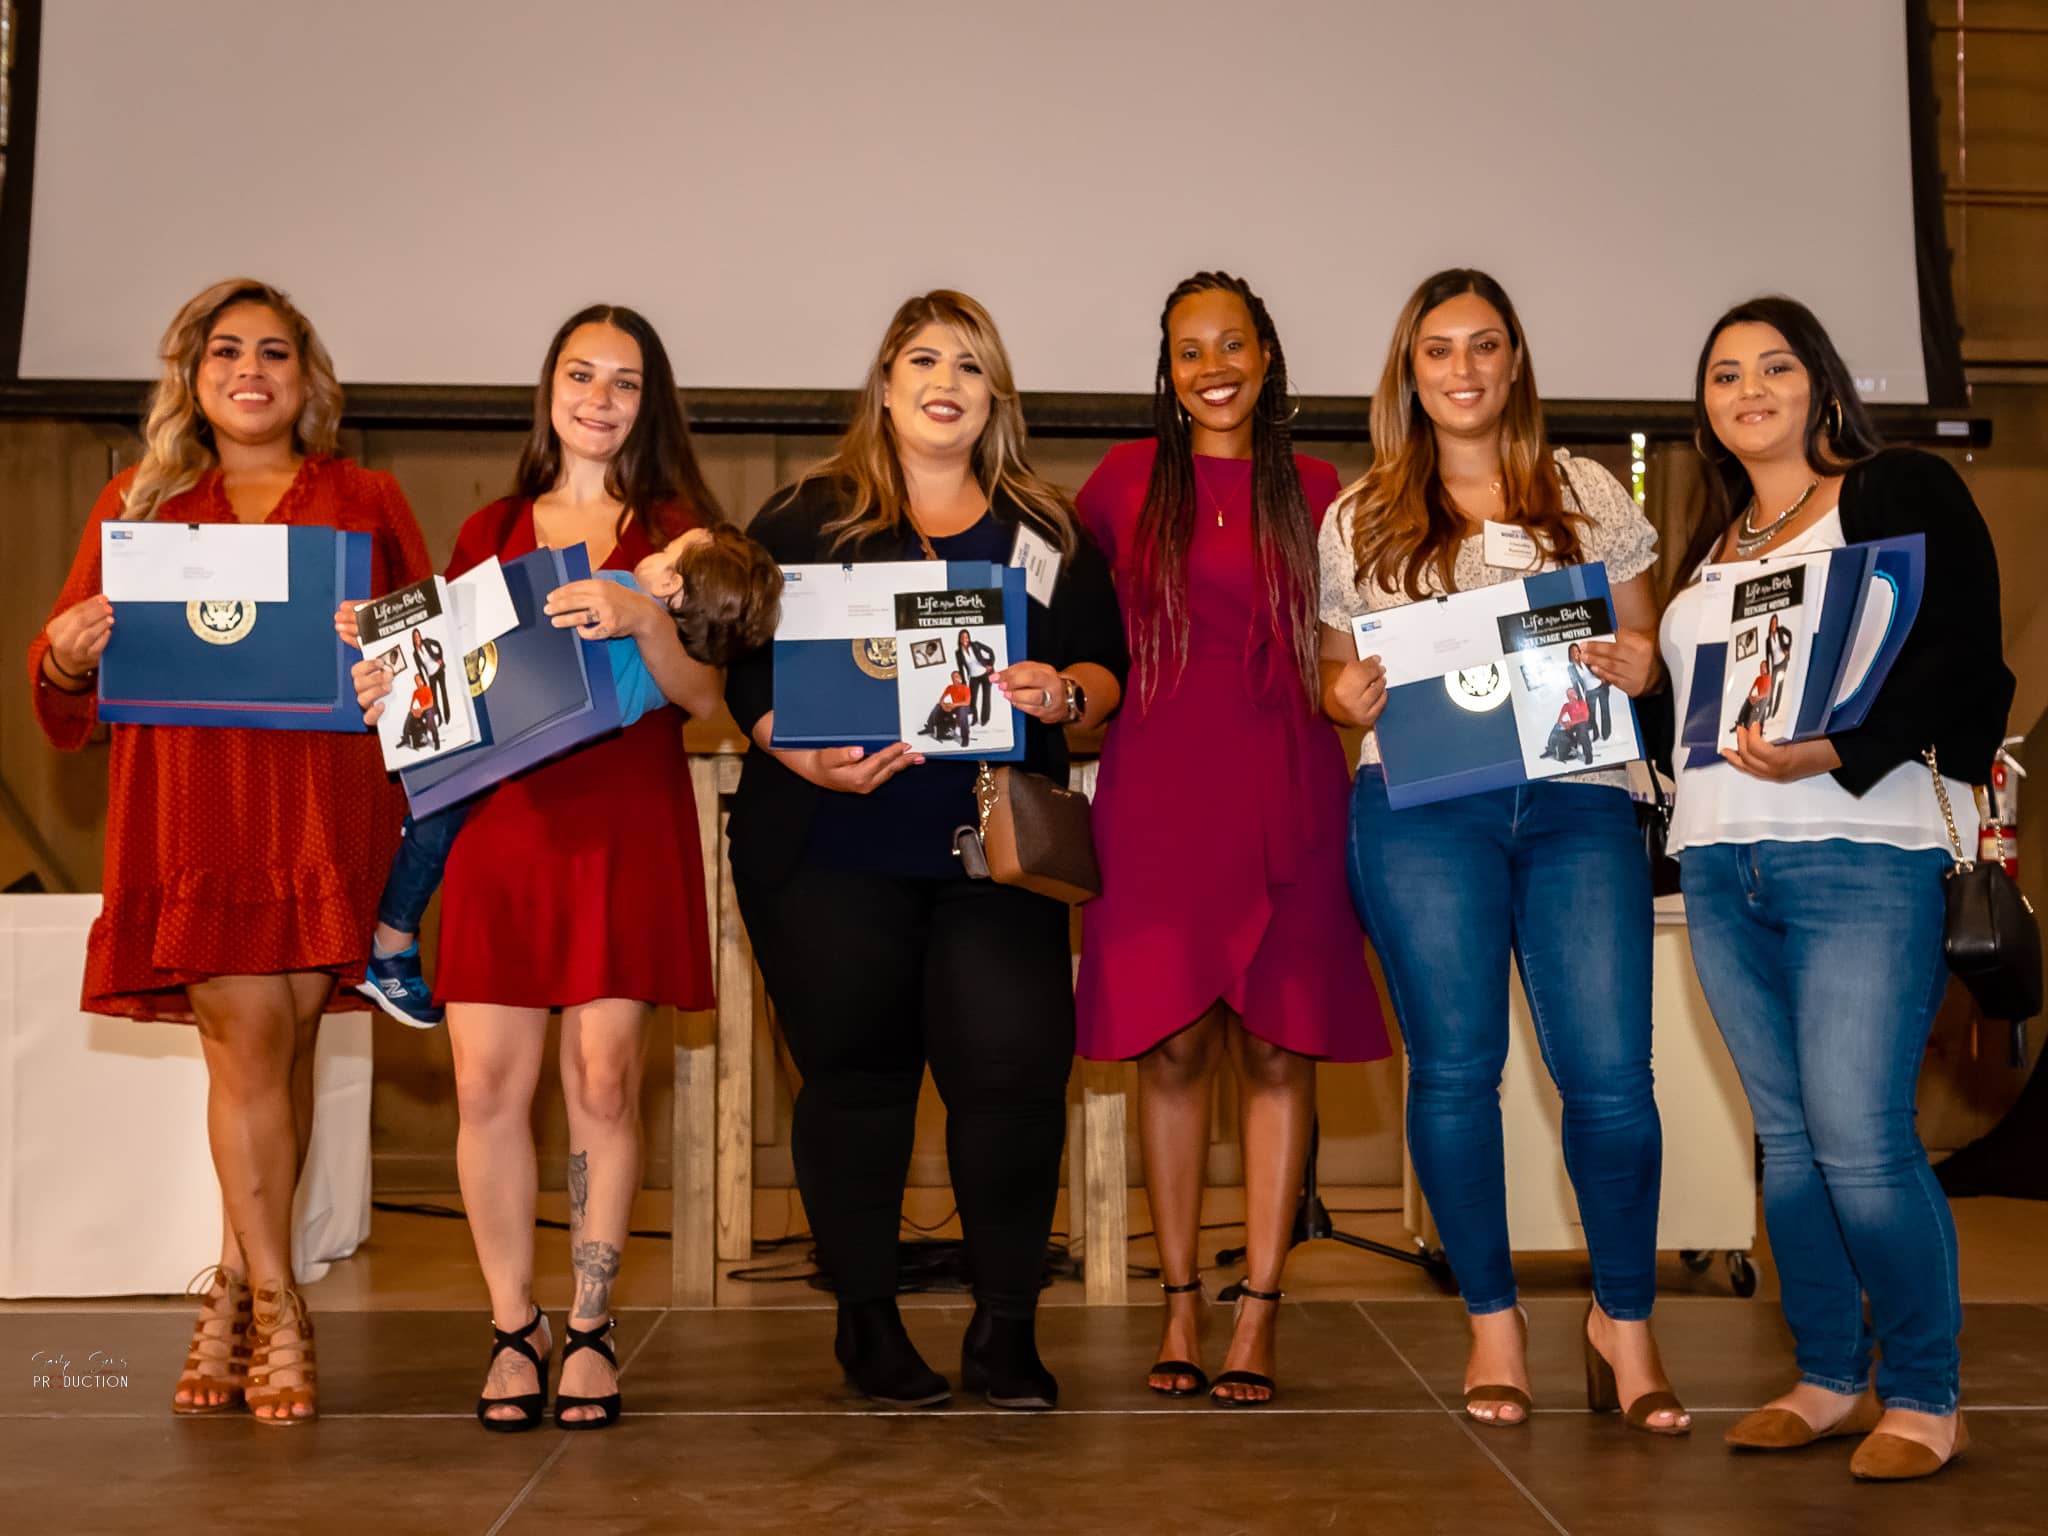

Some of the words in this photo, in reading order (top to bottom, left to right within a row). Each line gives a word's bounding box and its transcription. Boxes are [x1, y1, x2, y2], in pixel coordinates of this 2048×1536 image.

[373, 602, 392, 622] Life
[917, 596, 939, 614] Life
[955, 594, 986, 609] Birth
[918, 616, 953, 627] TEENAGE
[954, 615, 984, 625] MOTHER
[1521, 614, 1544, 633] Life
[1560, 605, 1592, 622] Birth
[1562, 627, 1592, 641] MOTHER
